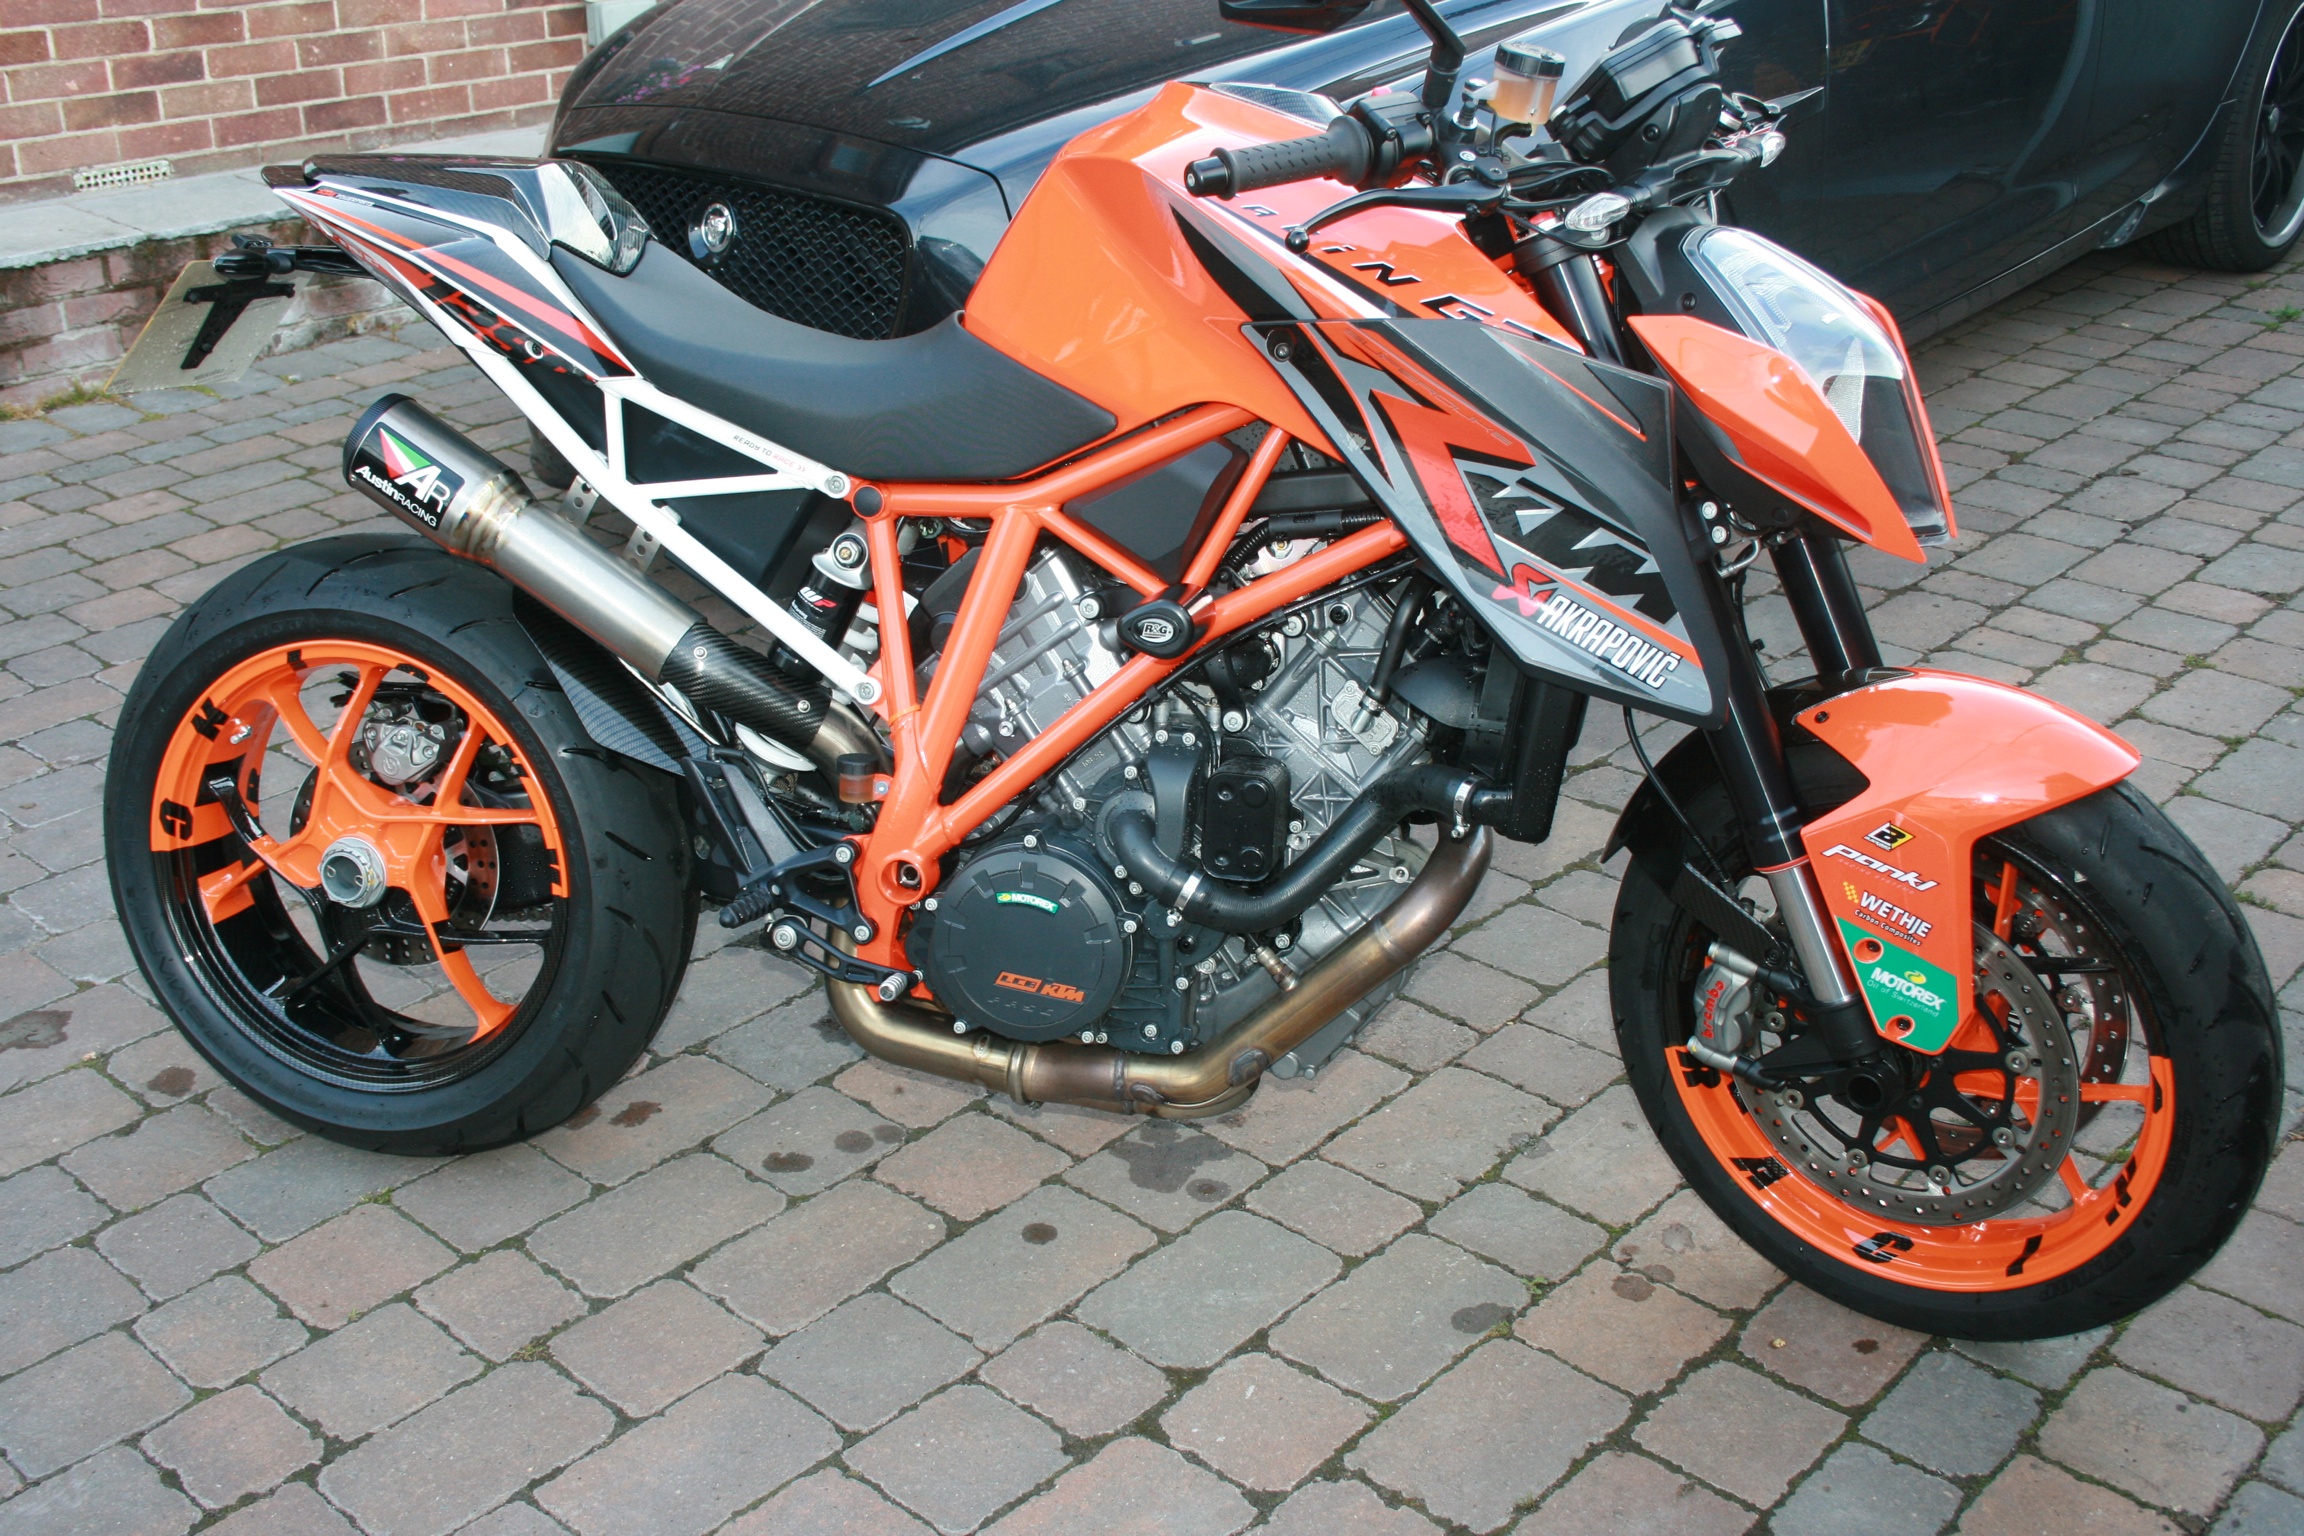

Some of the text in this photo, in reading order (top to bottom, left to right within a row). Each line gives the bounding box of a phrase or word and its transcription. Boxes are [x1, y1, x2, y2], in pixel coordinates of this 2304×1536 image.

[733, 434, 795, 468] READY TO RACE
[394, 465, 450, 513] AR
[799, 586, 838, 608] WP
[1144, 624, 1168, 635] R&G
[1011, 893, 1056, 912] MOTOREX
[1860, 890, 1933, 938] WETHJE
[1854, 909, 1922, 946] Carbon Composites
[1040, 982, 1086, 1003] KTM
[1866, 979, 1879, 990] Oil
[1891, 991, 1940, 1018] Switzerland
[1870, 967, 1947, 1011] MOTOREX
[1701, 980, 1726, 1039] brembo
